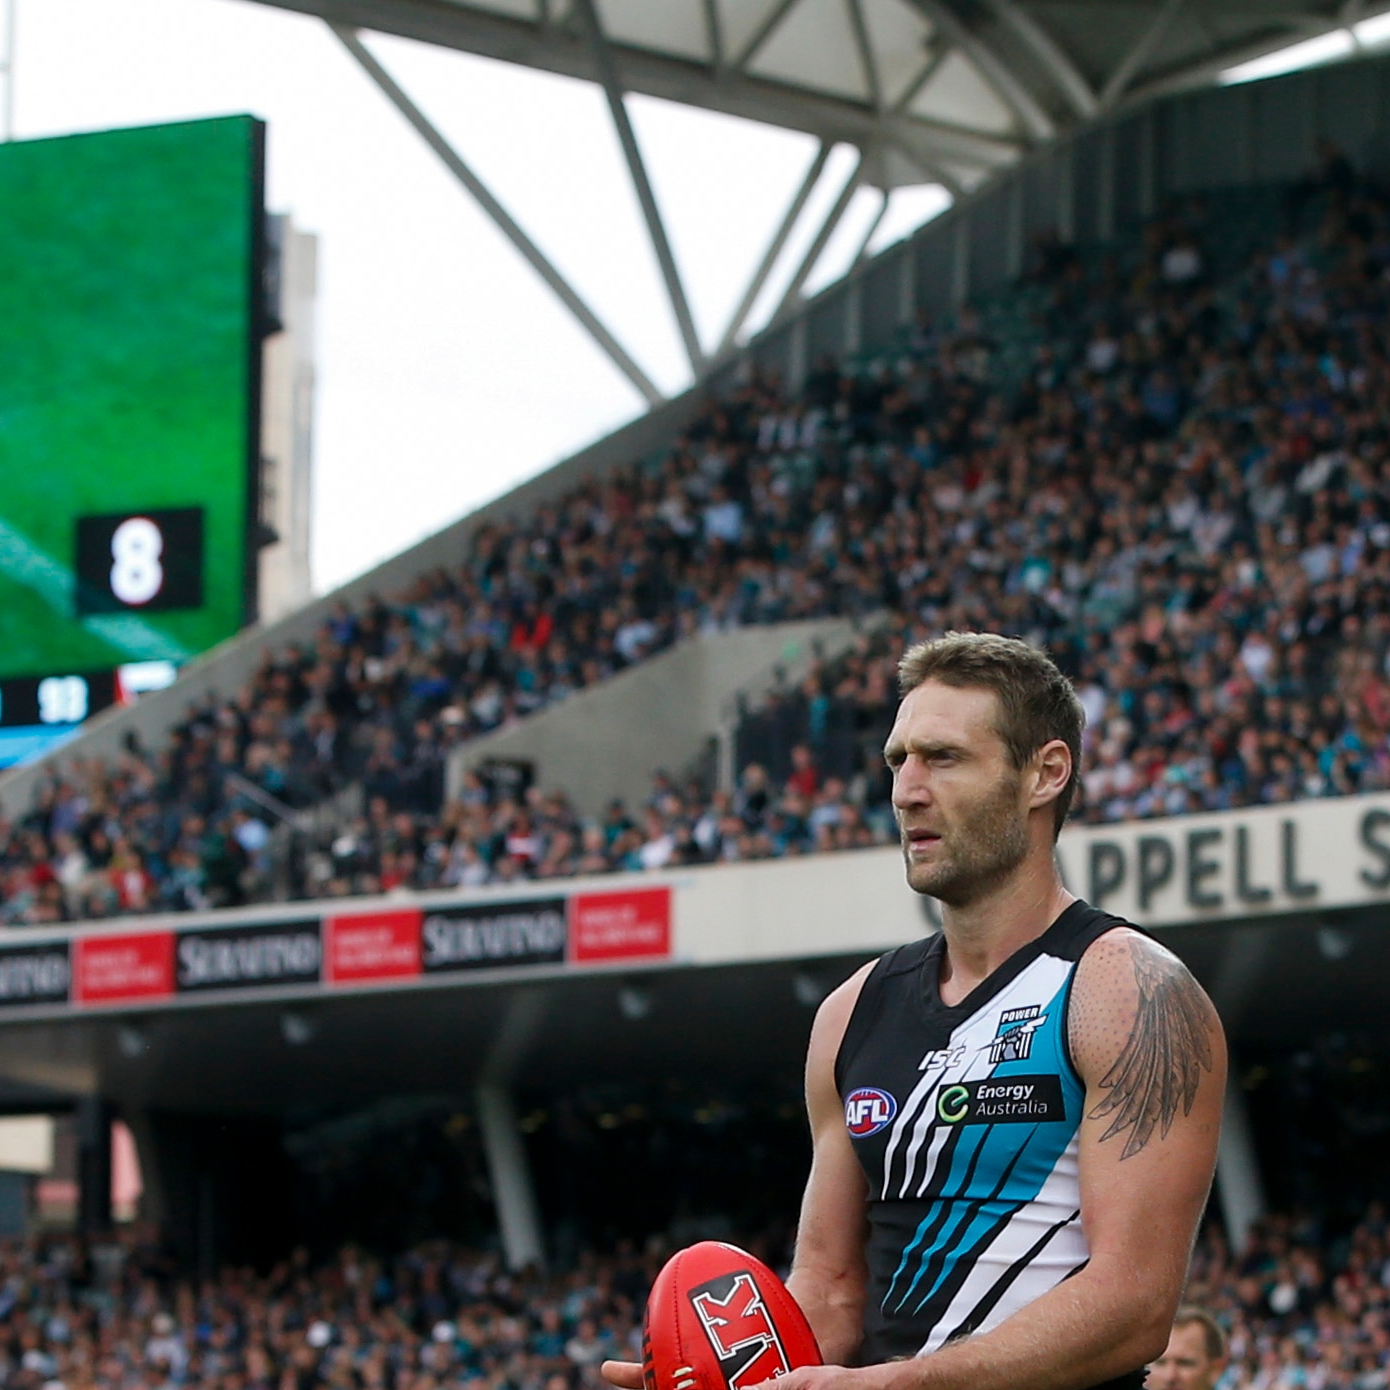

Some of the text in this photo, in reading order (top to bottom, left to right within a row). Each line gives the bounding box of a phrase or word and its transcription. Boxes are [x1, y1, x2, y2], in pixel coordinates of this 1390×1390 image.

[110, 515, 164, 607] 8
[1057, 820, 1320, 911] PPELL
[1001, 1007, 1039, 1023] POWER
[918, 1045, 967, 1071] ISC
[976, 1085, 1035, 1101] Energy
[846, 1099, 889, 1126] AFL
[975, 1099, 1048, 1116] Australia
